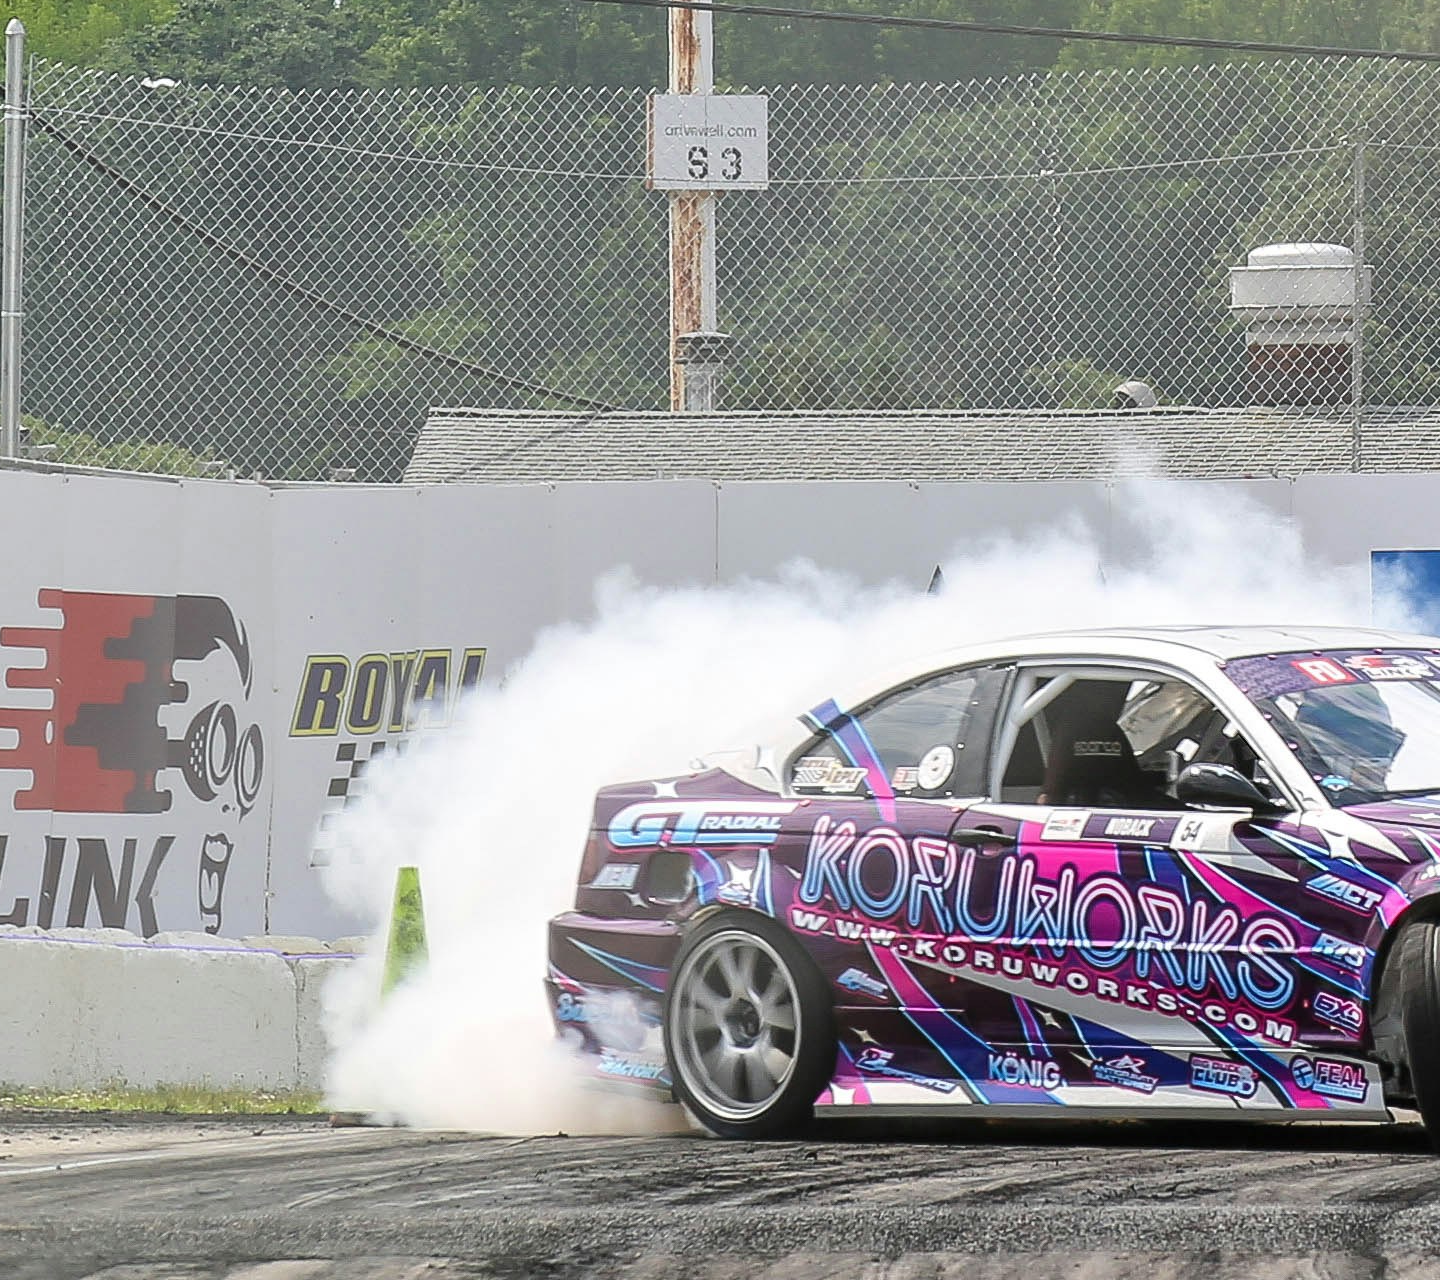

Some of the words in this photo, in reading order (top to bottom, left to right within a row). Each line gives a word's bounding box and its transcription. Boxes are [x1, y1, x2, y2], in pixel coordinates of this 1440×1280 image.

[720, 146, 743, 181] 3
[608, 800, 799, 847] GT
[699, 815, 783, 830] RADIAL
[1180, 820, 1204, 842] 54
[799, 814, 1297, 1012] KORUWORKS
[987, 1051, 1061, 1089] KÖNIG
[1193, 1068, 1239, 1087] CLUB
[1315, 1060, 1367, 1090] FEAL
